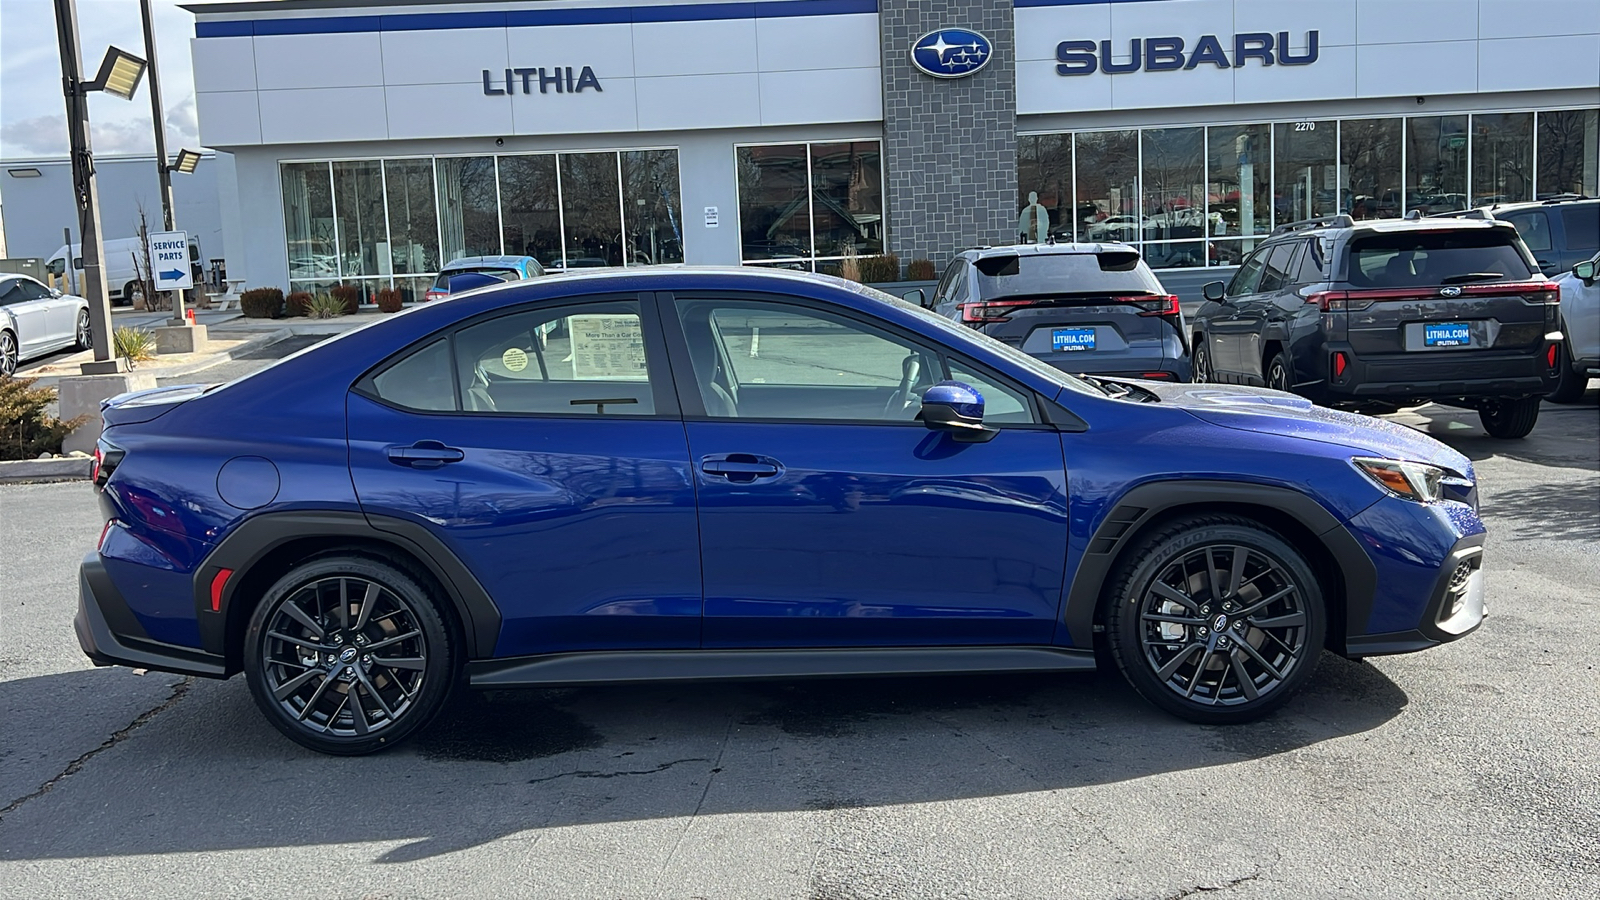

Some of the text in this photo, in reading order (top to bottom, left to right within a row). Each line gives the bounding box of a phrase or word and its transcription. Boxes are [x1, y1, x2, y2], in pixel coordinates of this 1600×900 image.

[1056, 30, 1319, 76] SUBARU
[482, 66, 603, 95] LITHIA
[1295, 122, 1315, 131] 2270
[153, 240, 185, 250] SERVICE
[159, 252, 183, 261] PARTS
[1053, 334, 1095, 344] LITHIA.COM
[1426, 330, 1468, 339] LITHIA.COM
[1153, 530, 1217, 566] DUNLOP
